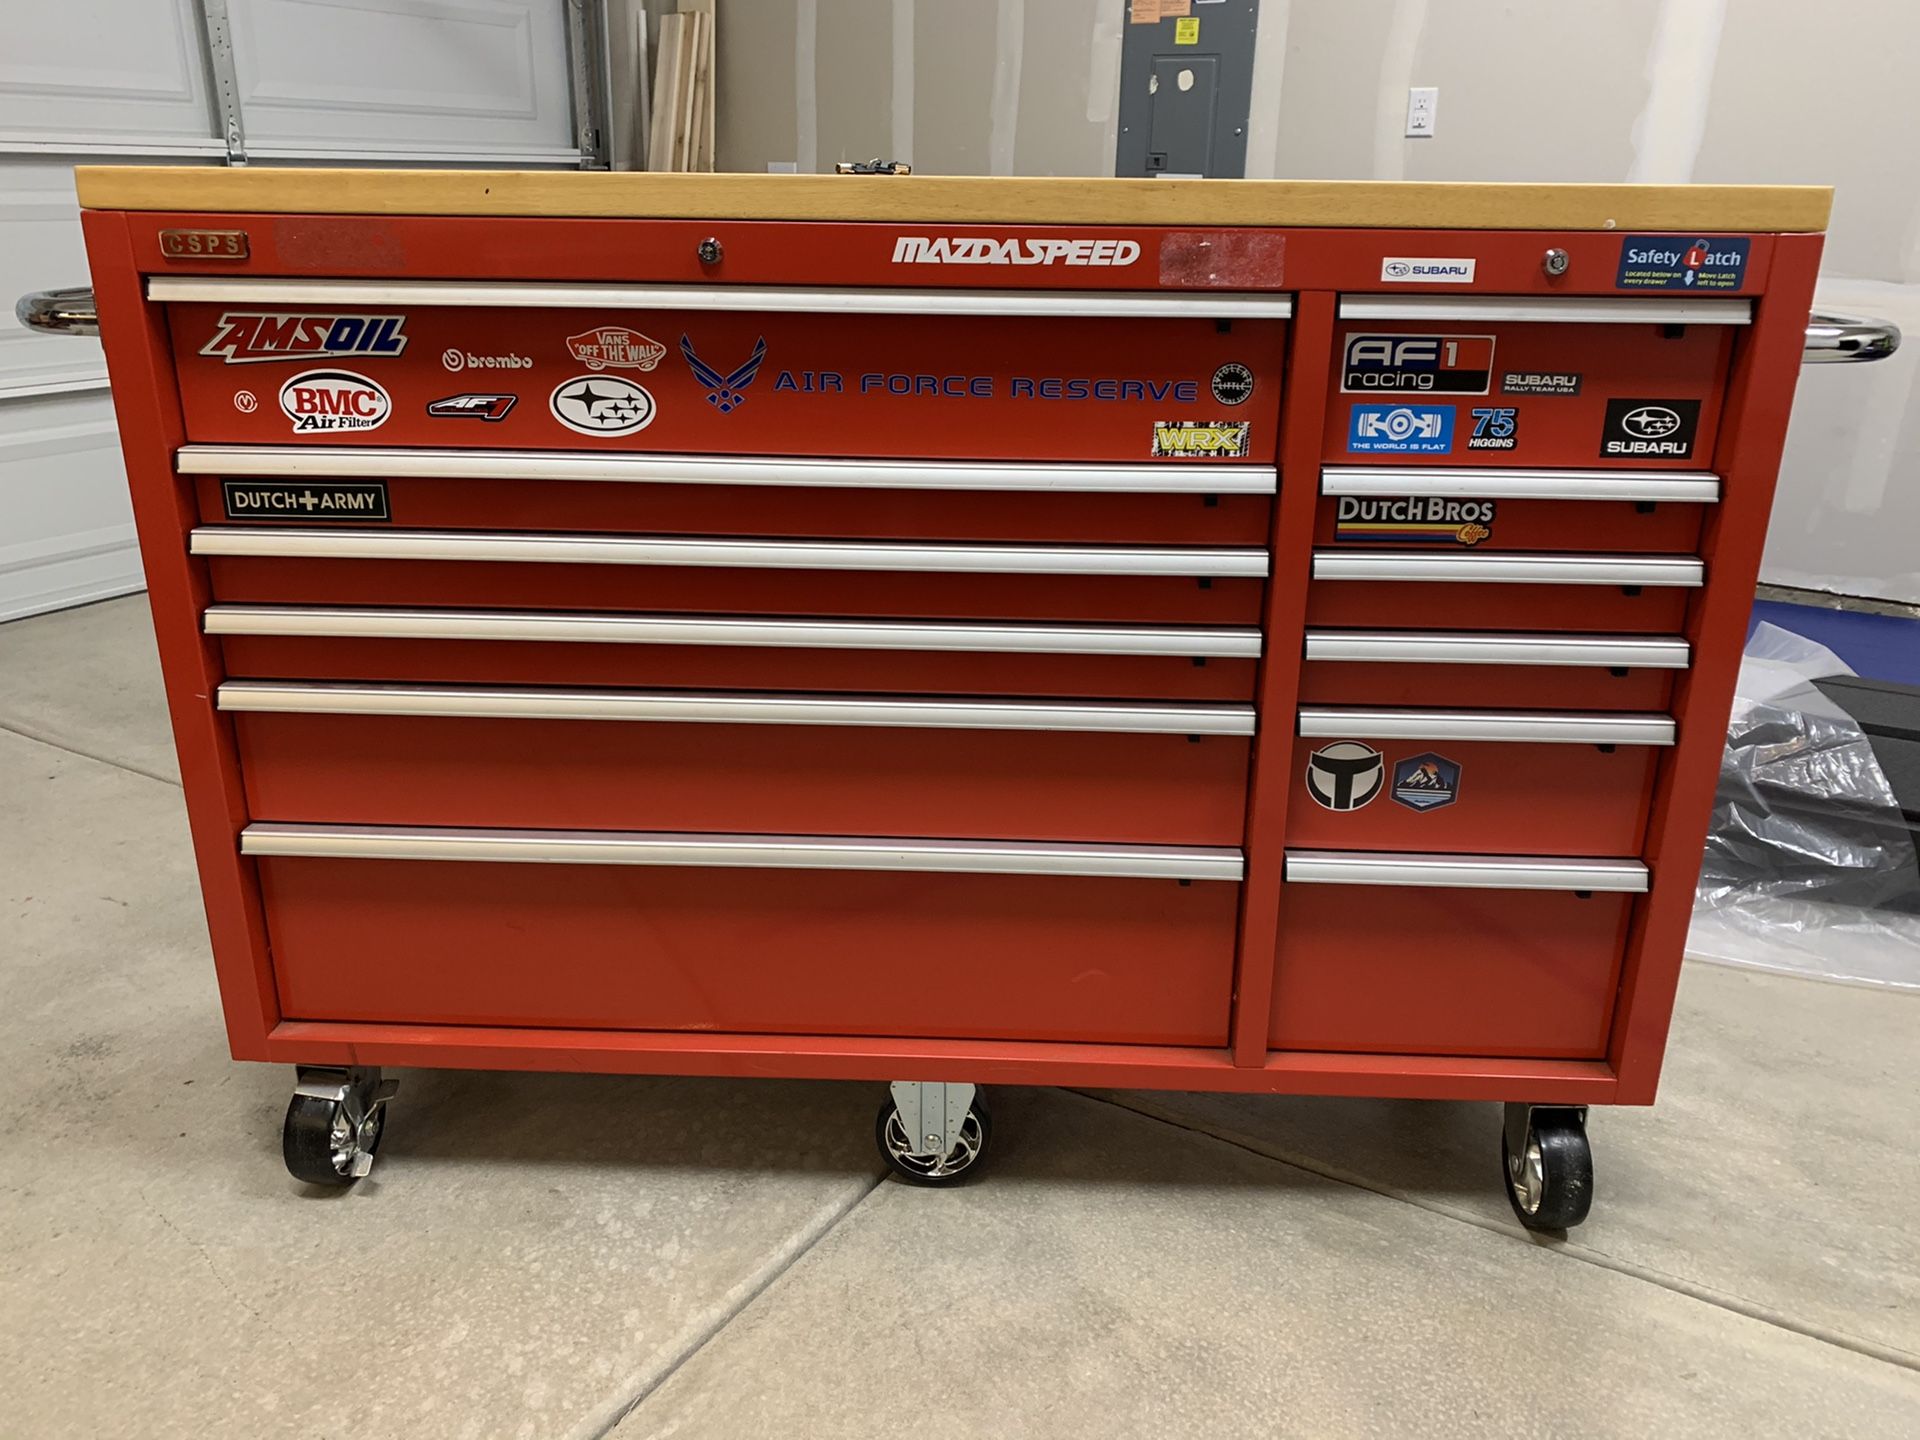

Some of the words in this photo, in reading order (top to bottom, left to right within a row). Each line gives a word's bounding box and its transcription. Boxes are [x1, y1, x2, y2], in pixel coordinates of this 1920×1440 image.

[169, 234, 241, 255] CSPS
[891, 236, 1141, 267] MAZDASPEED
[1627, 249, 1680, 267] Safety
[1689, 250, 1741, 266] Latch
[1411, 264, 1468, 277] SUBARU
[1625, 270, 1651, 278] Located
[1652, 271, 1671, 279] below
[1644, 278, 1668, 286] drawer
[1717, 280, 1735, 288] open
[207, 314, 402, 360] AMSOIL
[596, 331, 631, 346] VANS
[466, 352, 534, 369] brembo
[602, 344, 627, 362] THE
[1350, 340, 1458, 367] AF1
[773, 370, 844, 393] AIR
[859, 372, 993, 398] FORCE
[1010, 378, 1199, 402] RESERVE
[1347, 371, 1435, 389] racing
[1505, 374, 1577, 386] SUBARU
[292, 387, 377, 417] BMC
[297, 415, 336, 430] Air
[337, 416, 372, 429] Filter
[1471, 408, 1515, 437] 75
[1157, 428, 1241, 450] WRX
[1373, 442, 1407, 450] WORLD
[1422, 443, 1446, 451] FLAT
[1468, 438, 1514, 448] HIGGINS
[1606, 440, 1687, 454] SUBARU
[1456, 523, 1490, 545] Coffee
